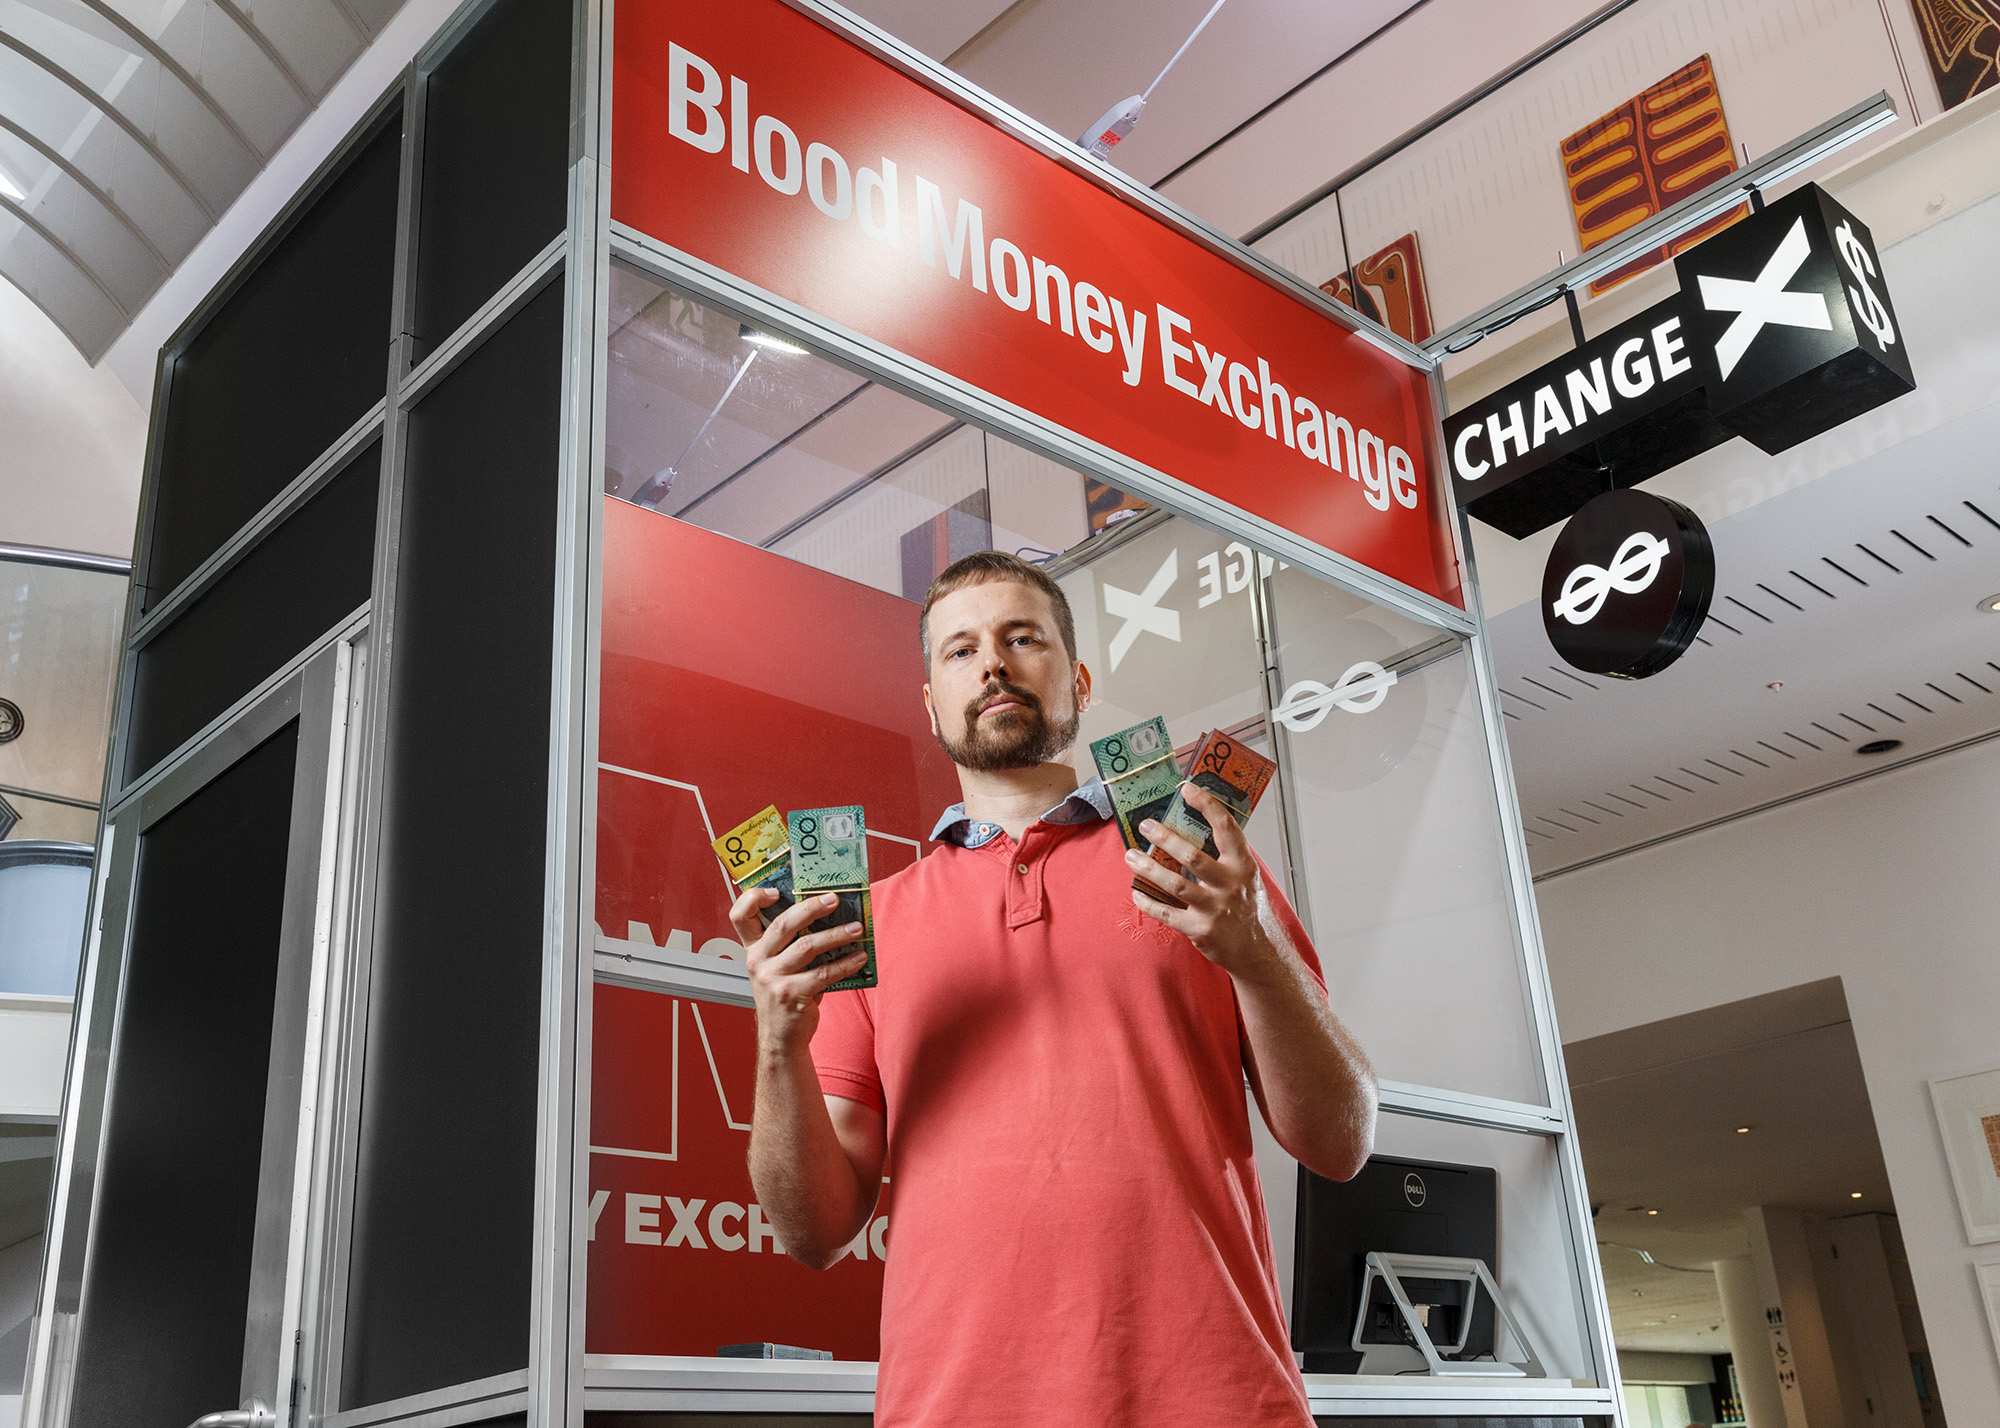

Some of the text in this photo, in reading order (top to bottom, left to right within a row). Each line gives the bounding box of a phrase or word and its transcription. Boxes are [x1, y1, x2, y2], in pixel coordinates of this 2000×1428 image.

[668, 40, 1418, 513] Blood Money Exchange
[1453, 316, 1693, 482] CHANGE
[1105, 739, 1129, 774] 00
[1203, 740, 1232, 774] 20
[725, 835, 752, 869] 50
[798, 817, 819, 859] 100
[1407, 1185, 1424, 1194] DELL
